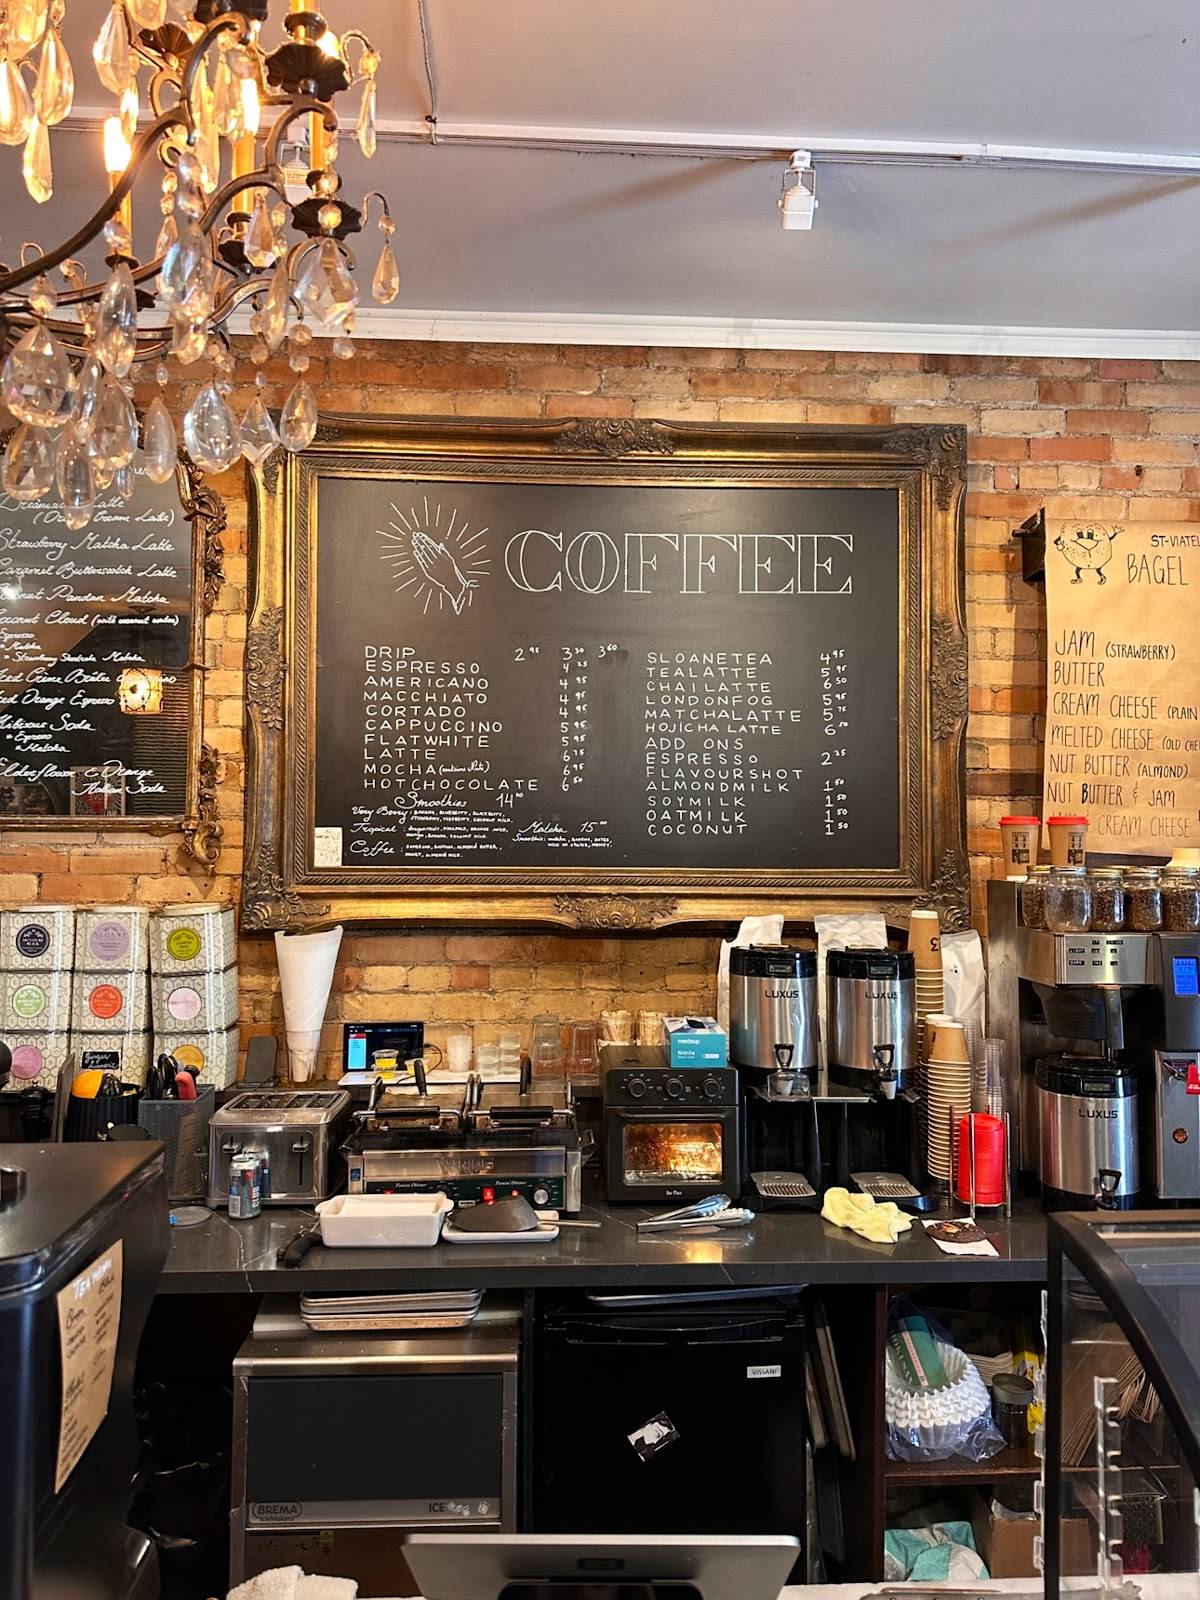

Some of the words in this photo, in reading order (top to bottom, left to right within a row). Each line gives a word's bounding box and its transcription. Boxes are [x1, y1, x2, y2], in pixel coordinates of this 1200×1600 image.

[70, 532, 130, 550] Matcha
[131, 533, 175, 551] Latte
[505, 530, 853, 594] COFFEE
[56, 560, 132, 579] Butterscotch
[137, 563, 178, 578] Latte
[1127, 553, 1188, 586] BAGEL
[46, 584, 106, 601] Pandan
[111, 585, 170, 603] Matcha
[44, 609, 87, 625] Cloud
[1055, 629, 1095, 657] JAM
[1105, 641, 1176, 661] (STRAWBERRY)
[364, 646, 416, 659] DRIP
[365, 660, 480, 674] ESPRESSO
[1054, 660, 1105, 687] BUTTER
[364, 676, 489, 690] AMERICANO
[21, 688, 66, 710] Orange
[363, 690, 488, 704] MACCHIATO
[365, 704, 466, 718] CORTADO
[1053, 691, 1100, 717] CREAM
[1109, 694, 1158, 720] CHEESE
[50, 713, 96, 731] Soda
[365, 719, 503, 733] CAPPUCCINO
[645, 722, 720, 733] HOJICHA
[727, 724, 782, 735] LATTE
[645, 737, 686, 750] ADD
[703, 738, 744, 750] ONS
[1052, 725, 1103, 748] MELTED
[1111, 727, 1154, 750] CHEESE
[1162, 736, 1181, 750] (OLD
[364, 748, 437, 760] LATTE
[646, 752, 758, 765] ESPRESSO
[102, 760, 155, 781] Orange
[364, 763, 438, 776] MOCHA
[1049, 754, 1077, 774] NUT
[1084, 754, 1130, 777] BUTTER
[1137, 762, 1188, 778] (ALMOND)
[126, 780, 168, 794] Soda
[394, 790, 467, 809] Smoothies
[1047, 782, 1074, 803] NUT
[1081, 783, 1123, 806] BUTTER
[1148, 790, 1176, 807] JAM
[351, 806, 374, 822] Very
[350, 823, 397, 835] Tropical
[519, 821, 568, 833] Matcha
[648, 824, 747, 837] COCONUT
[1097, 814, 1143, 836] CREAM
[1150, 815, 1191, 837] CHEESE
[350, 839, 395, 857] Coffee
[765, 990, 799, 999] LUXUS
[865, 991, 898, 1000] LUXUS
[1079, 1108, 1118, 1118] LUXUS
[257, 1505, 298, 1514] BREMA
[429, 1503, 445, 1513] ICE
